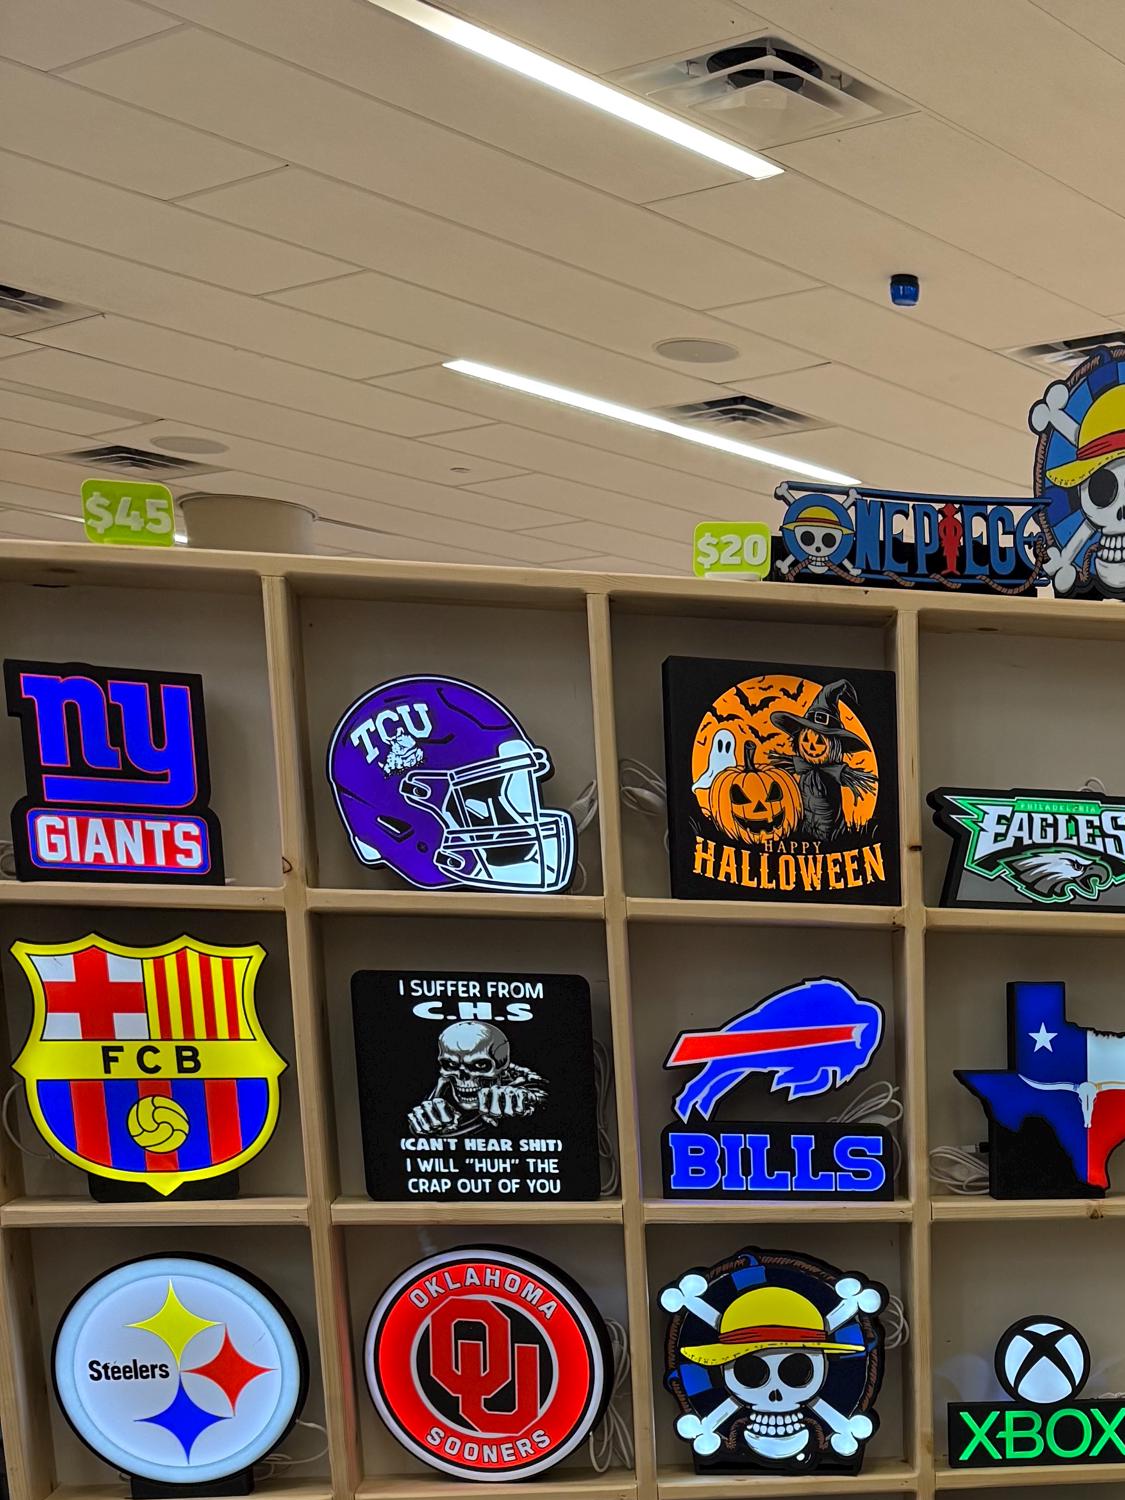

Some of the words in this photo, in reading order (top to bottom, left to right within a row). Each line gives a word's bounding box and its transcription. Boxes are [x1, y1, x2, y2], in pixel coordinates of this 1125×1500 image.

[86, 491, 171, 534] $45
[697, 532, 767, 569] $20
[350, 703, 432, 764] TCU
[36, 815, 204, 868] GIANTS
[764, 840, 822, 854] HAPPY
[692, 836, 887, 891] HALLOWEEN
[399, 979, 405, 996] I
[410, 980, 480, 997] SUFFER
[487, 981, 544, 999] FROM
[412, 1001, 534, 1022] C.H.S
[400, 1138, 458, 1151] (CAN'T
[464, 1138, 513, 1152] HEAR
[519, 1139, 563, 1152] SHIT)
[670, 1132, 886, 1192] BILLS
[406, 1158, 411, 1172] I
[417, 1158, 459, 1173] WILL
[526, 1159, 559, 1173] THE
[408, 1178, 451, 1193] CRAP
[457, 1178, 492, 1193] OUT
[498, 1178, 521, 1193] OF
[527, 1179, 561, 1194] YOU
[409, 1267, 558, 1320] OKLAHOMA
[88, 1359, 170, 1381] Steelers
[426, 1427, 552, 1463] SOONERS
